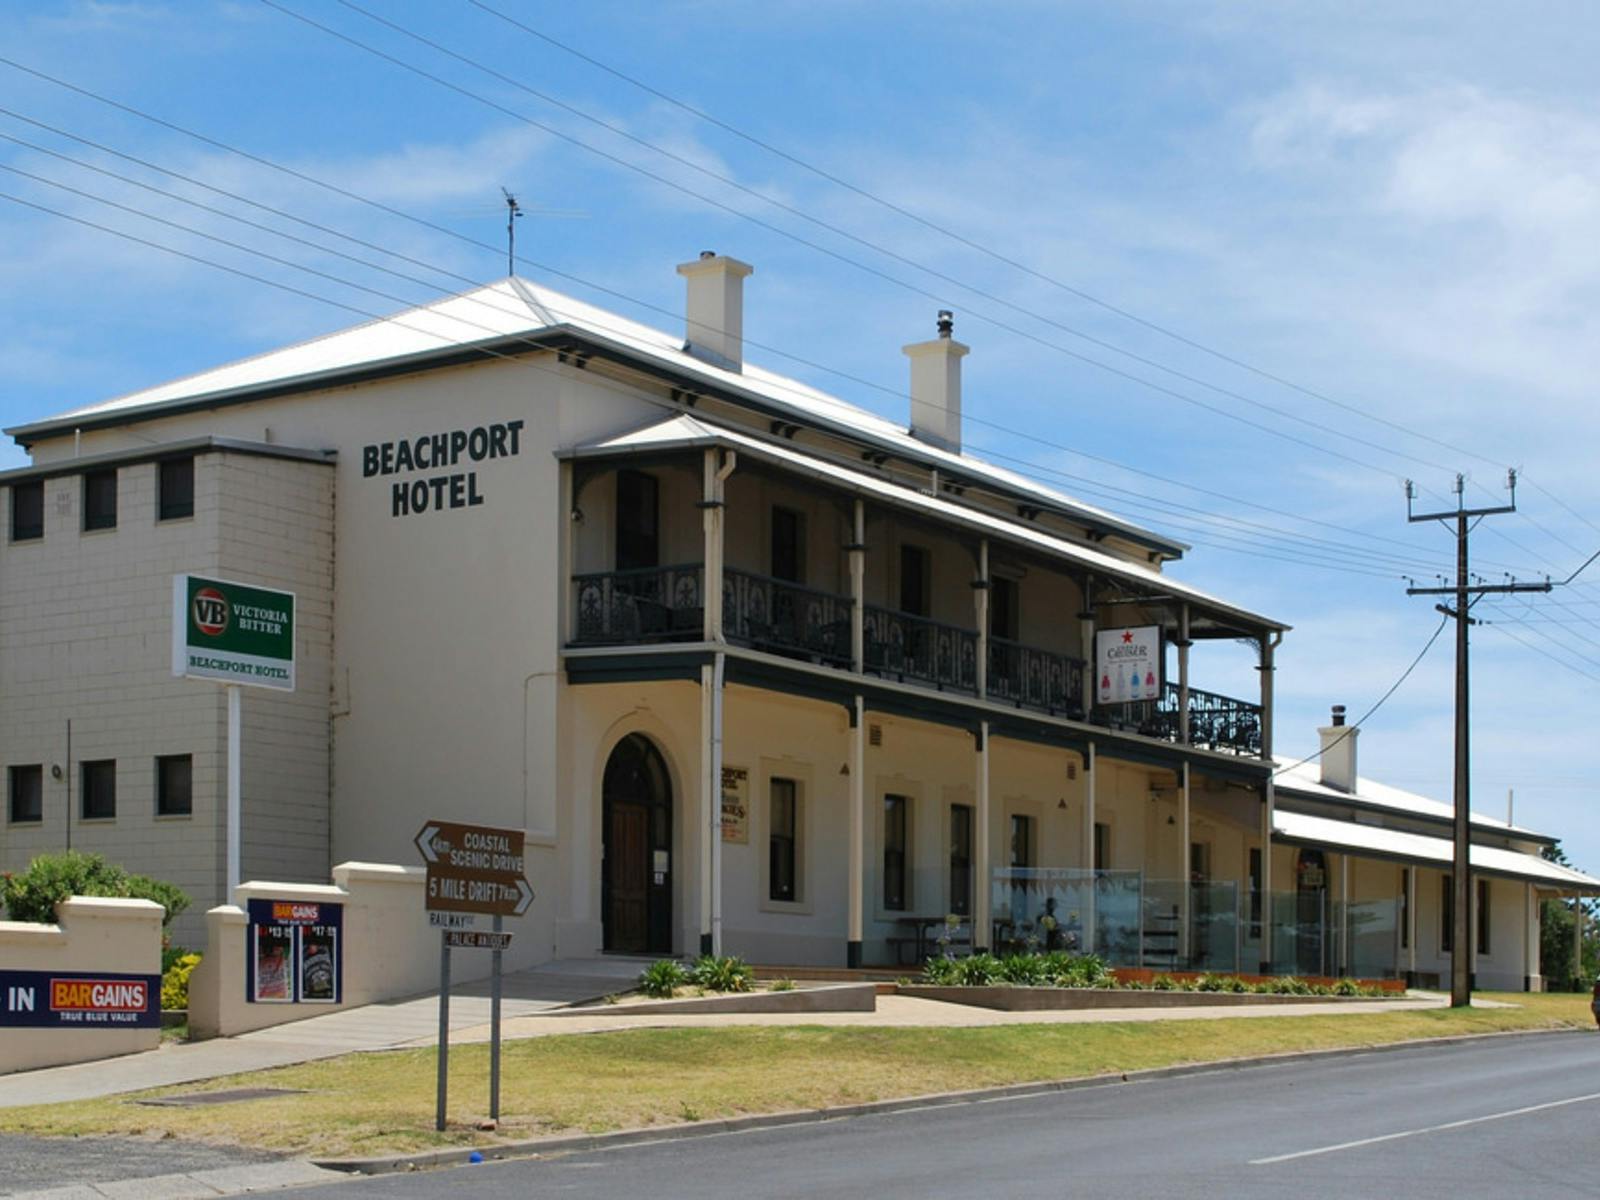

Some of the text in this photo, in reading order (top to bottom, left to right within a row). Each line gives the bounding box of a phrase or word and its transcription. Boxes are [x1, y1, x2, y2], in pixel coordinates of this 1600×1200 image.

[363, 420, 524, 478] BEACHPORT
[392, 472, 484, 517] HOTEL
[195, 598, 226, 625] VB
[233, 604, 289, 624] VICTORIA
[239, 618, 282, 635] BITTER
[190, 656, 289, 680] BEACHPORT HOTEL
[464, 831, 511, 853] COASTAL
[450, 849, 524, 872] SCENIC DRIVE
[430, 877, 437, 897] 5
[440, 878, 465, 900] MILE
[468, 880, 497, 903] DRIFT
[273, 903, 318, 919] BARGAINS
[430, 912, 465, 929] RAILWAY
[8, 987, 35, 1012] IN
[55, 983, 144, 1008] BARGAINS
[60, 1012, 138, 1022] TRUE BLUE VALUE
